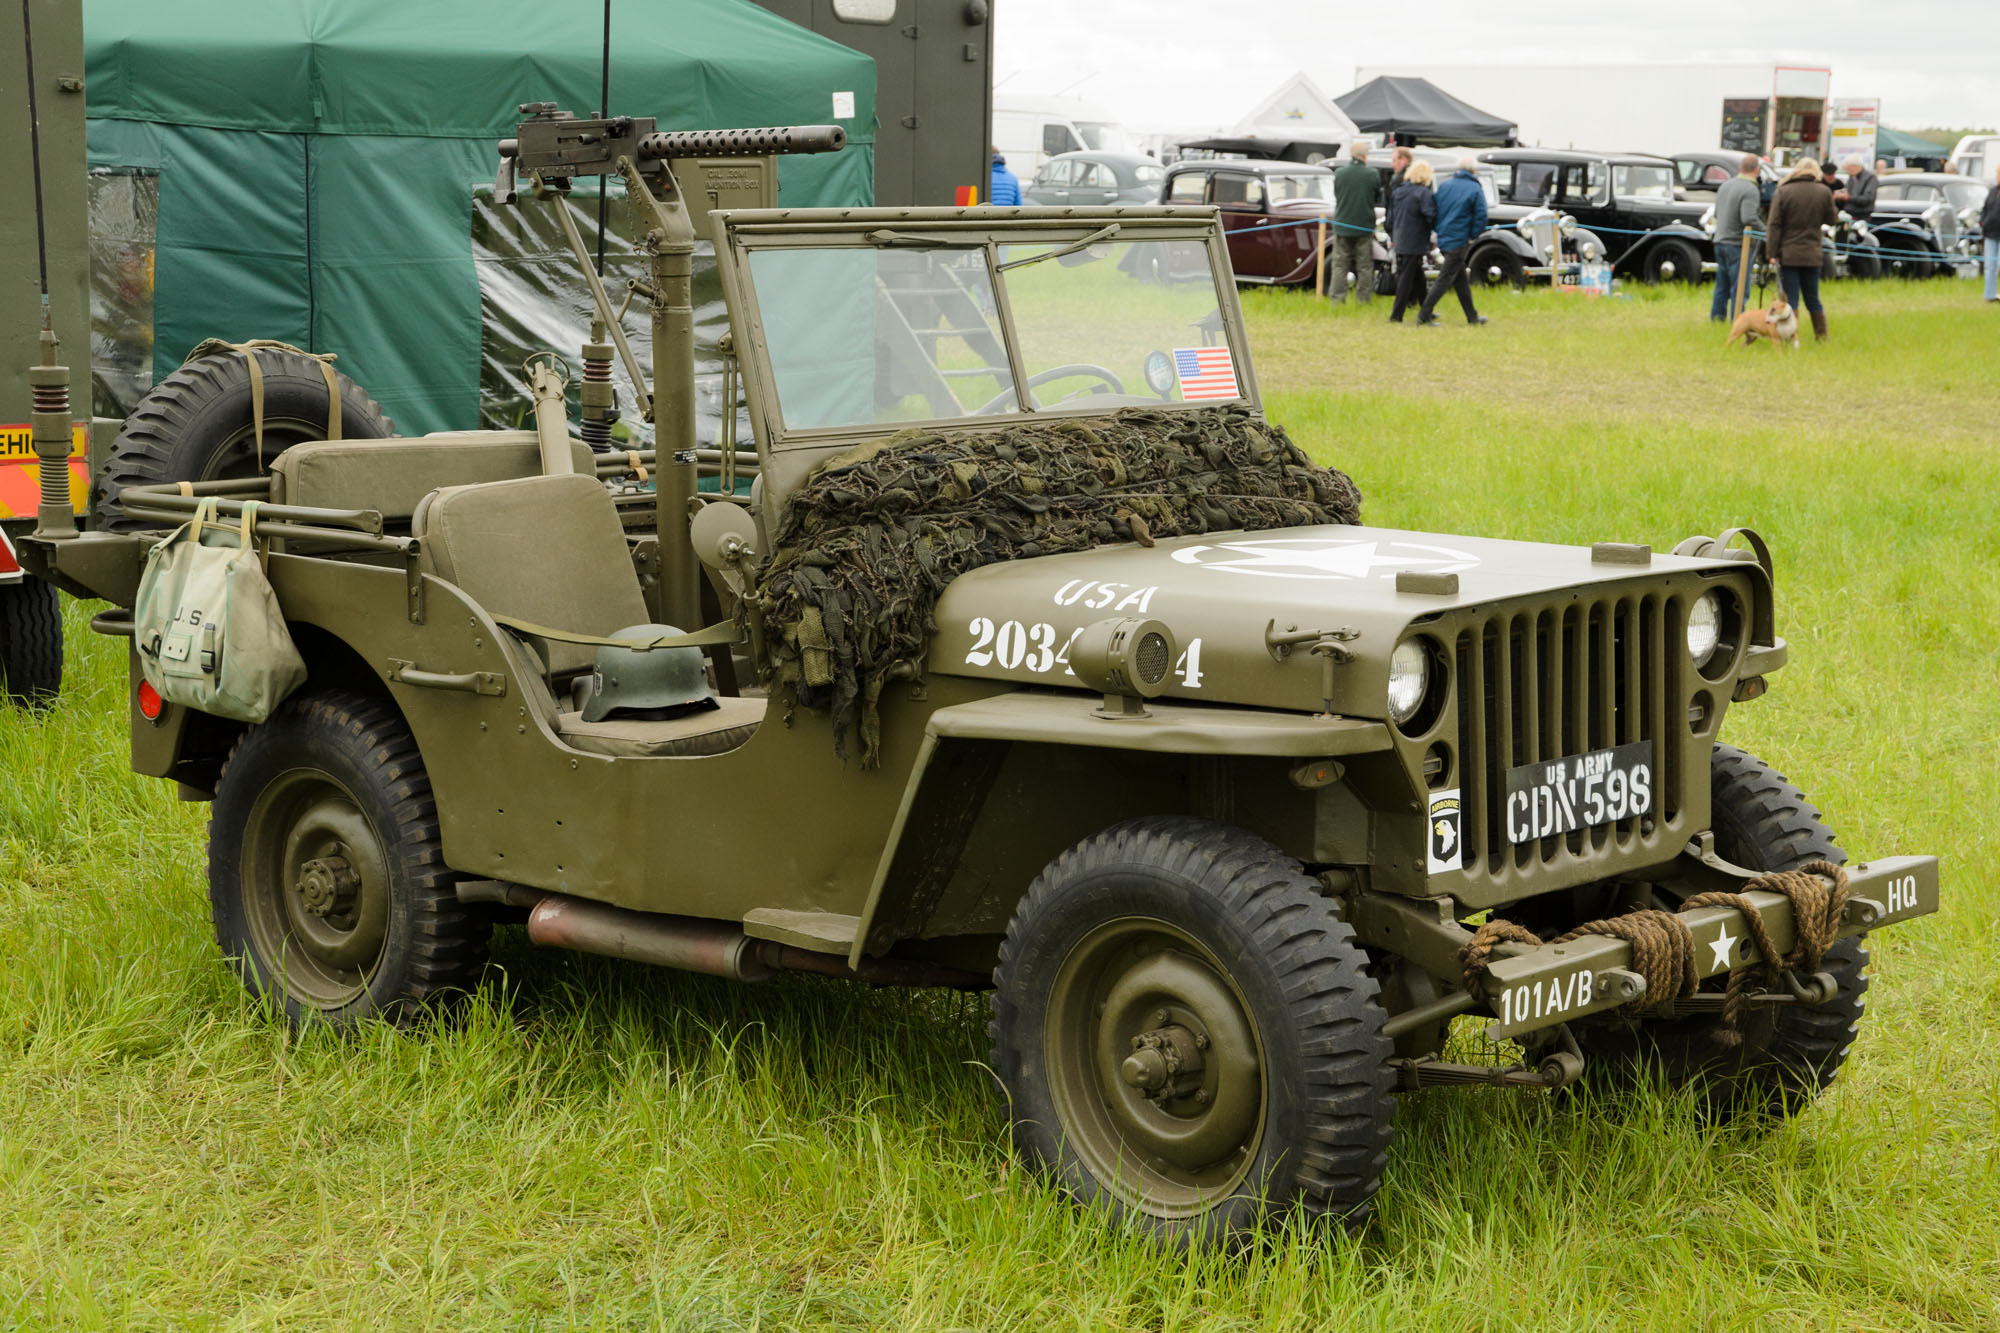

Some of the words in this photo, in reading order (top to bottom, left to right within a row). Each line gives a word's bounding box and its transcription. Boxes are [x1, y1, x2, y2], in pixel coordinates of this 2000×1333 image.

[1053, 579, 1159, 613] USA
[1546, 763, 1566, 785] US
[1575, 752, 1614, 779] ARMY
[1431, 799, 1459, 814] AIRBORNE
[1507, 779, 1577, 844] CDN
[1888, 875, 1918, 914] HQ
[1501, 970, 1593, 1026] 101A/B
